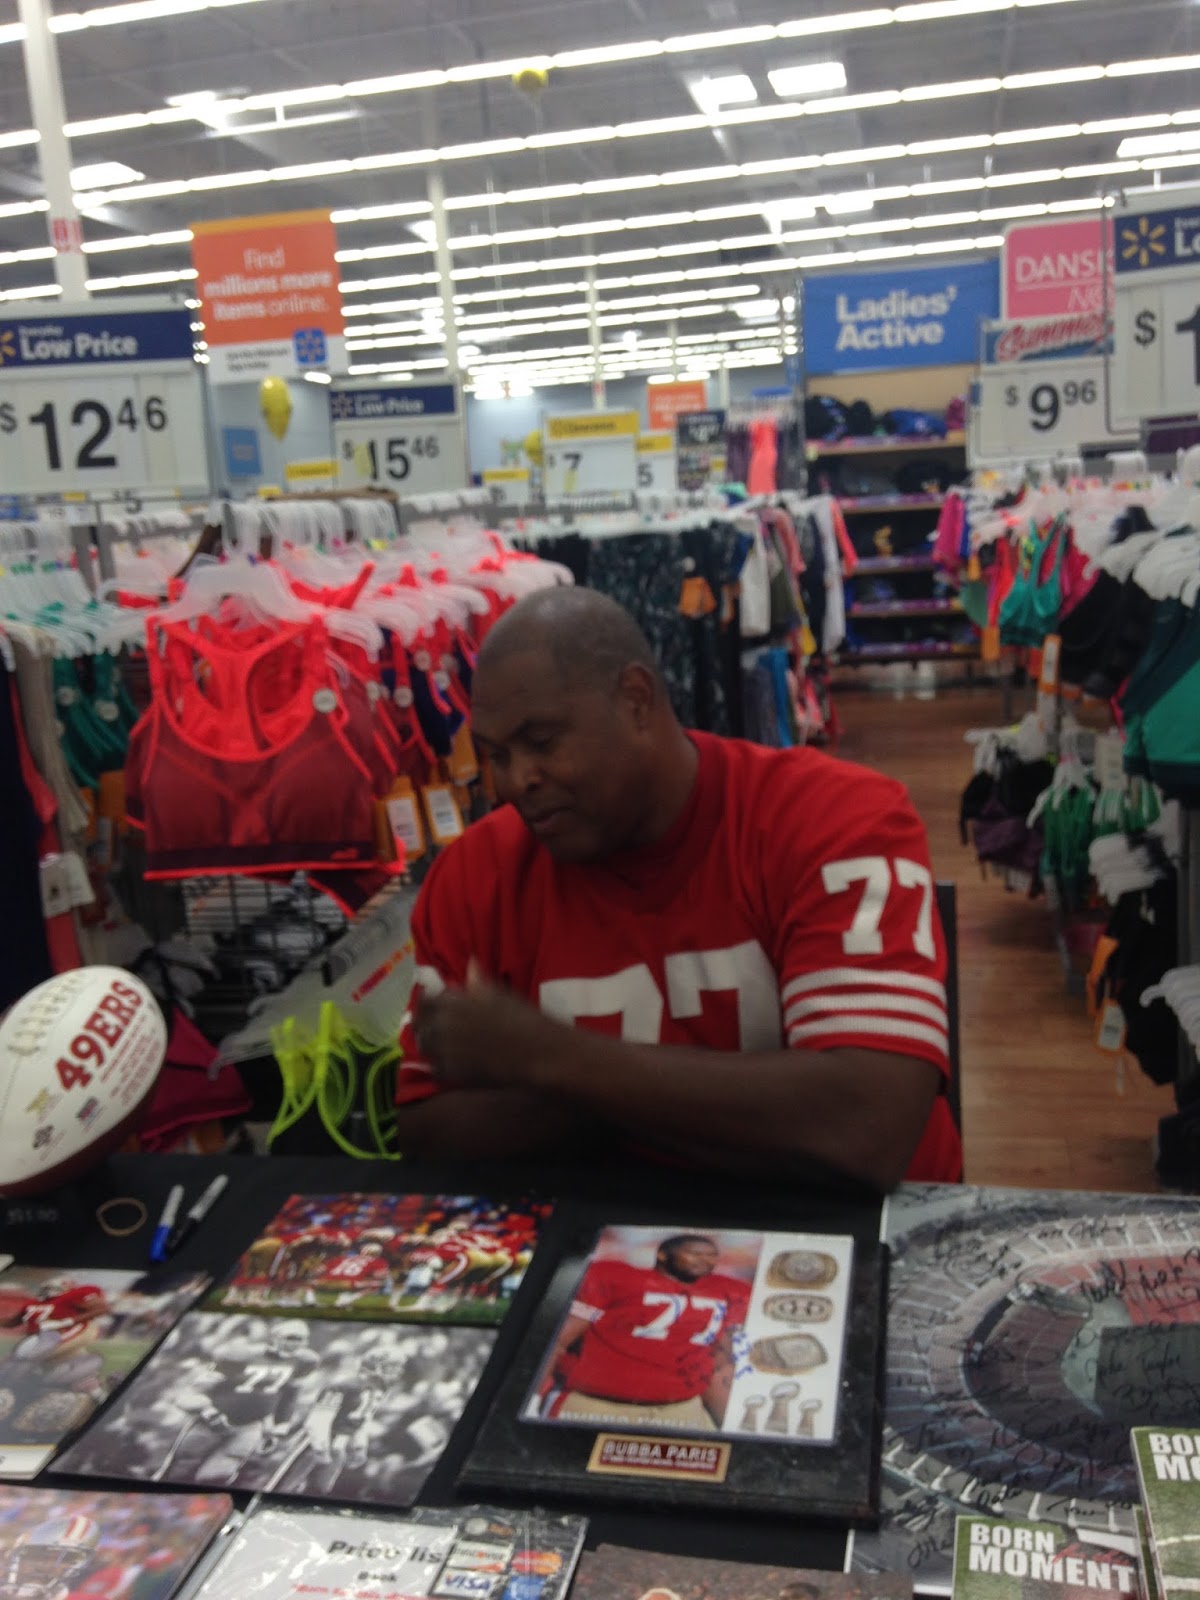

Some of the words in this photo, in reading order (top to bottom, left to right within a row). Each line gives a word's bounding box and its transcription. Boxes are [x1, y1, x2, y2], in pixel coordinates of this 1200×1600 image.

[243, 246, 285, 270] Find
[204, 274, 278, 298] millions
[280, 271, 332, 291] more
[212, 301, 267, 321] items
[835, 283, 958, 324] Ladies'
[20, 327, 73, 361] Low
[74, 331, 138, 358] Price
[835, 320, 945, 353] Active
[1134, 308, 1157, 350] $
[386, 396, 424, 415] Price
[822, 857, 936, 961] 77
[539, 939, 783, 1053] 77
[55, 980, 144, 1091] 49ERS
[631, 1291, 728, 1347] 77
[234, 1363, 297, 1394] 77
[602, 1440, 662, 1460] BUBBA
[665, 1445, 719, 1464] PARIS
[970, 1523, 1055, 1554] BORN
[445, 1574, 492, 1591] VISA
[968, 1545, 1135, 1593] MOMENT
